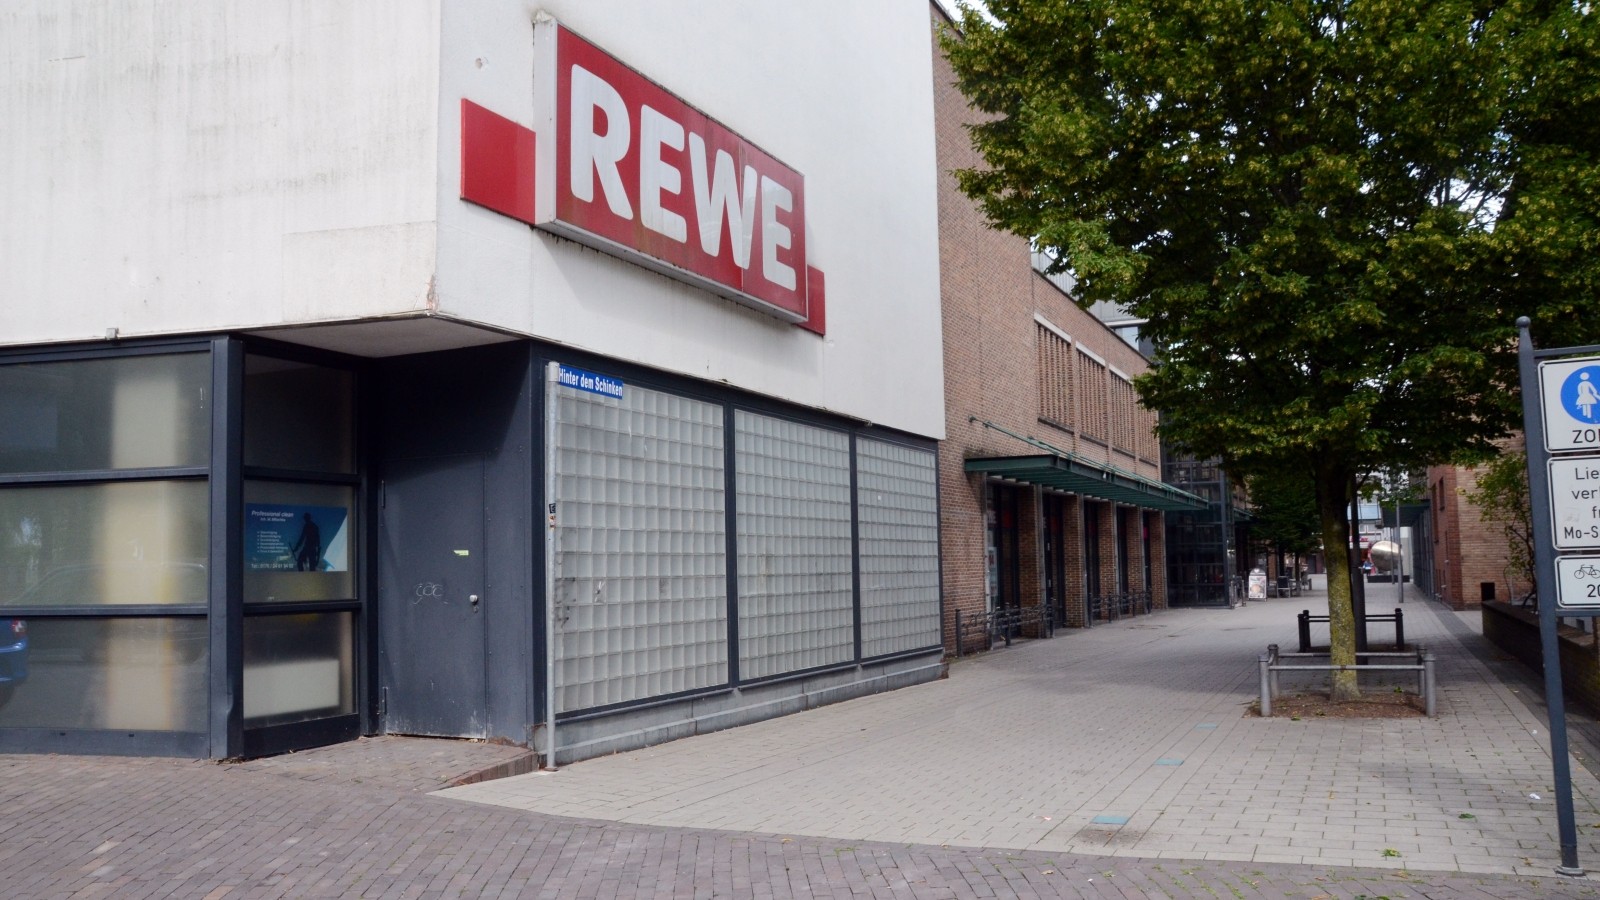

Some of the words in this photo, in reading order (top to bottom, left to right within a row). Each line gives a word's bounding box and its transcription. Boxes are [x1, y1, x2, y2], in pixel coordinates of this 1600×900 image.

[570, 63, 797, 292] REWE
[558, 367, 579, 386] Hinter
[580, 373, 594, 390] dem
[595, 376, 623, 397] Schinken
[1572, 429, 1600, 443] ZO
[1571, 486, 1600, 500] ver
[1592, 506, 1600, 518] f
